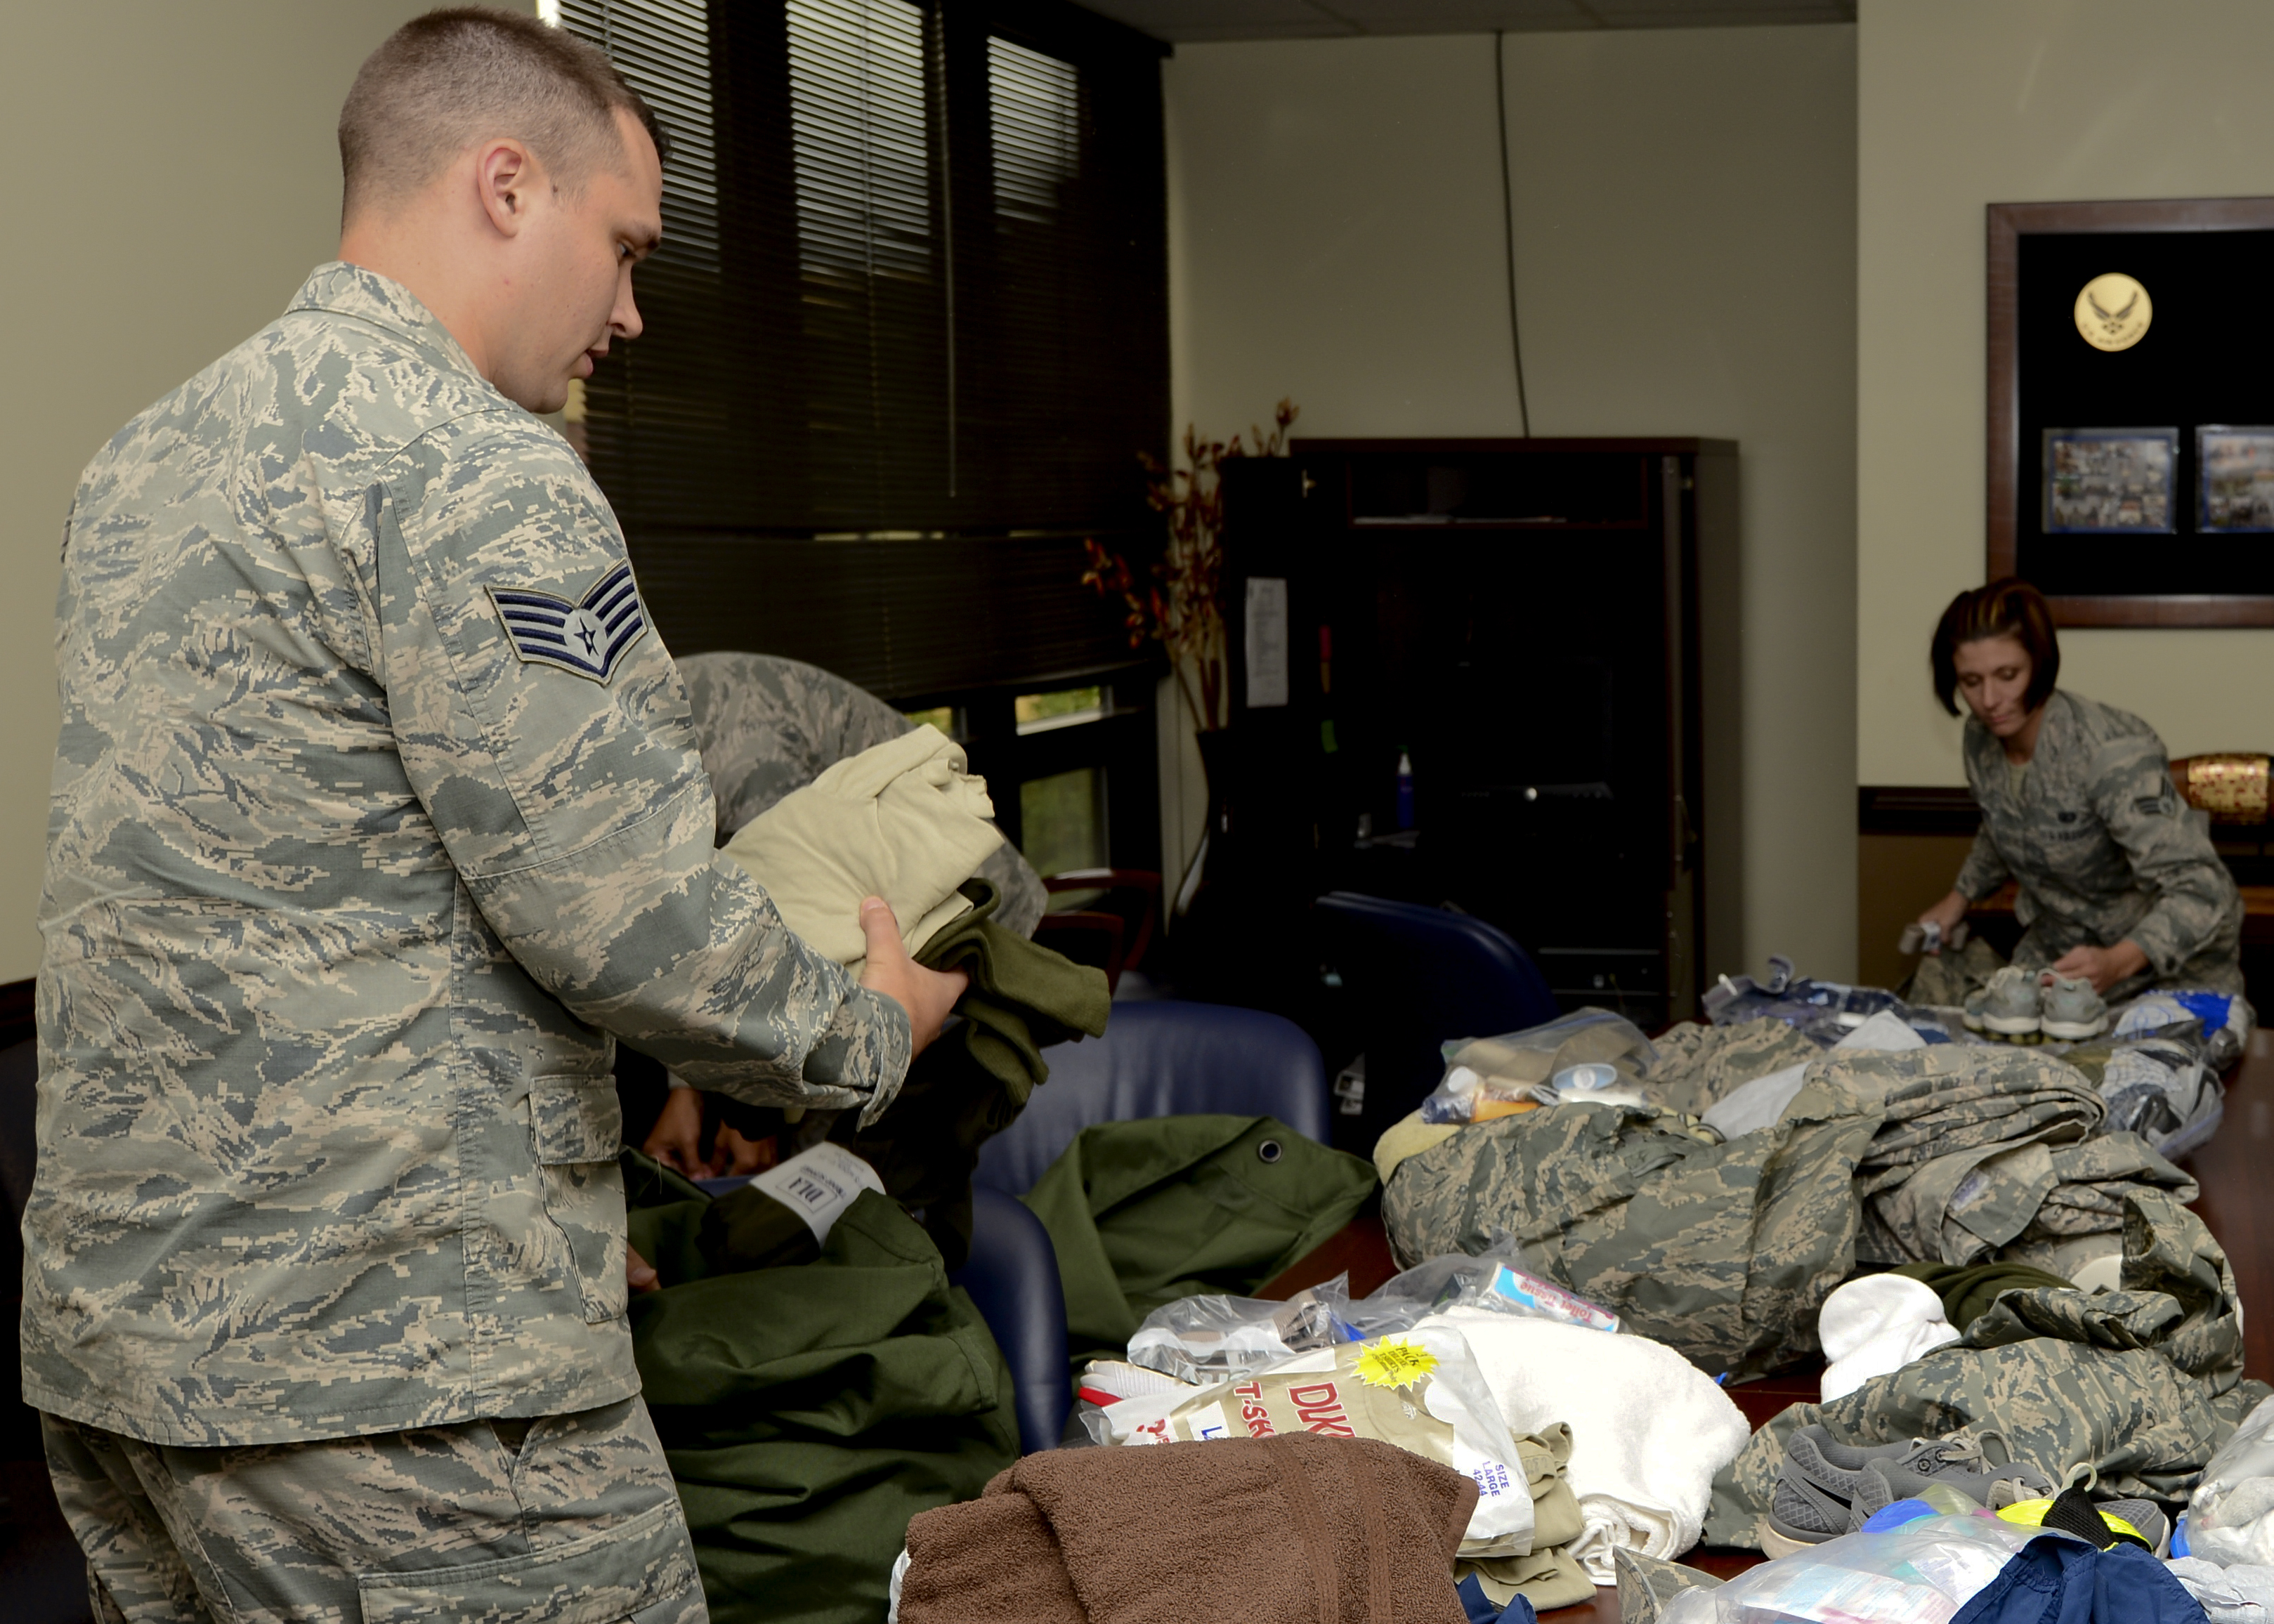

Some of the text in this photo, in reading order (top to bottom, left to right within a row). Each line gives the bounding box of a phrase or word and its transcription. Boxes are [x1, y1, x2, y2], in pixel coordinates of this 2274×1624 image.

[1520, 1281, 1557, 1307] Tissue
[1560, 1299, 1593, 1323] Toilet
[1234, 1381, 1276, 1439] T-SH
[1287, 1382, 1357, 1438] DUK
[1472, 1469, 1489, 1496] 42-44
[1482, 1460, 1501, 1497] LARGE
[1495, 1464, 1510, 1489] SIZE
